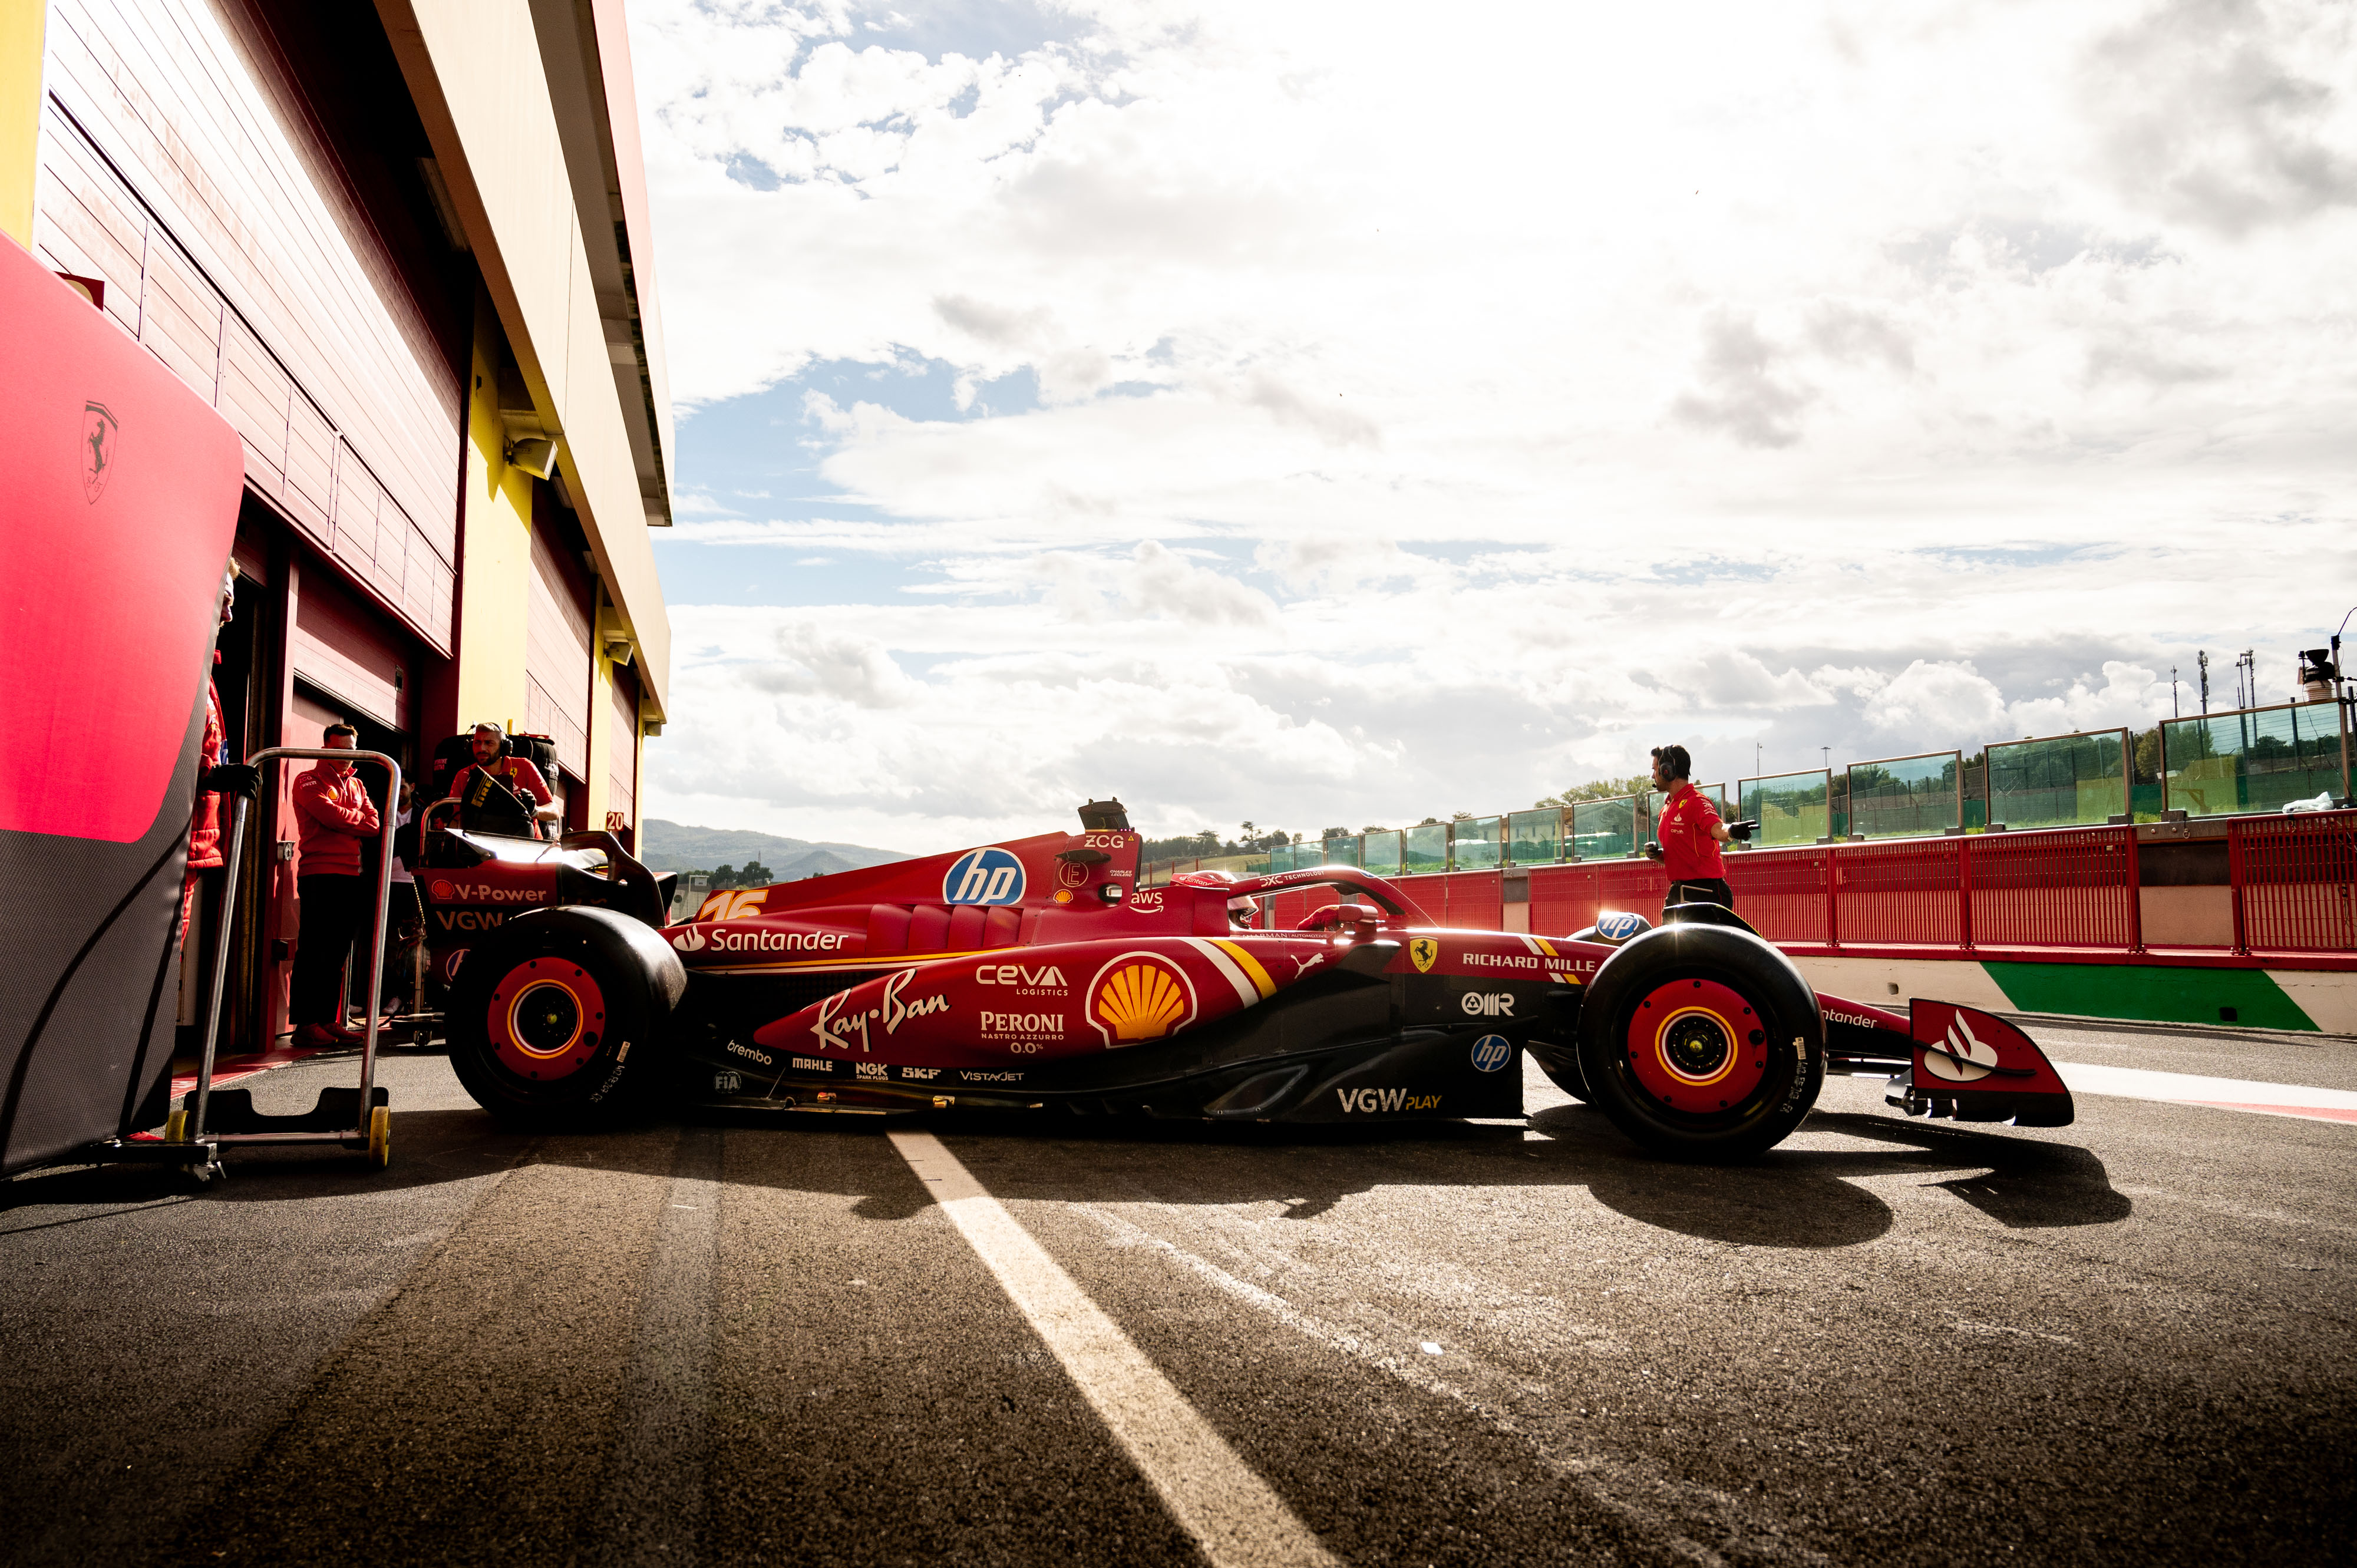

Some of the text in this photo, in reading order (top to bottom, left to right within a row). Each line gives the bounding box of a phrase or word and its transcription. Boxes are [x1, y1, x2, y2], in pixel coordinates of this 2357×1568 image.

[607, 813, 623, 830] 20
[1084, 834, 1124, 849] ZCG
[952, 848, 1017, 905] hp
[1259, 875, 1283, 887] DXC
[1284, 870, 1325, 880] TECHNOLOGY
[455, 884, 546, 902] V-Power
[1131, 892, 1163, 905] aws
[699, 889, 769, 922] 16
[436, 911, 503, 930] VGW
[711, 928, 849, 952] Santander
[1463, 953, 1596, 972] RICHARD MILLE
[1016, 988, 1068, 996] LOGISTICS
[980, 1011, 1064, 1032] PERONI
[1822, 1008, 1877, 1028] ntander
[727, 1039, 772, 1065] brembo
[1010, 1042, 1044, 1054] 0.0%
[1477, 1035, 1507, 1072] hp
[793, 1057, 833, 1072] MAHLE
[856, 1062, 888, 1077] NGK
[902, 1067, 941, 1080] SKF
[1337, 1088, 1442, 1113] VGW PLAY
